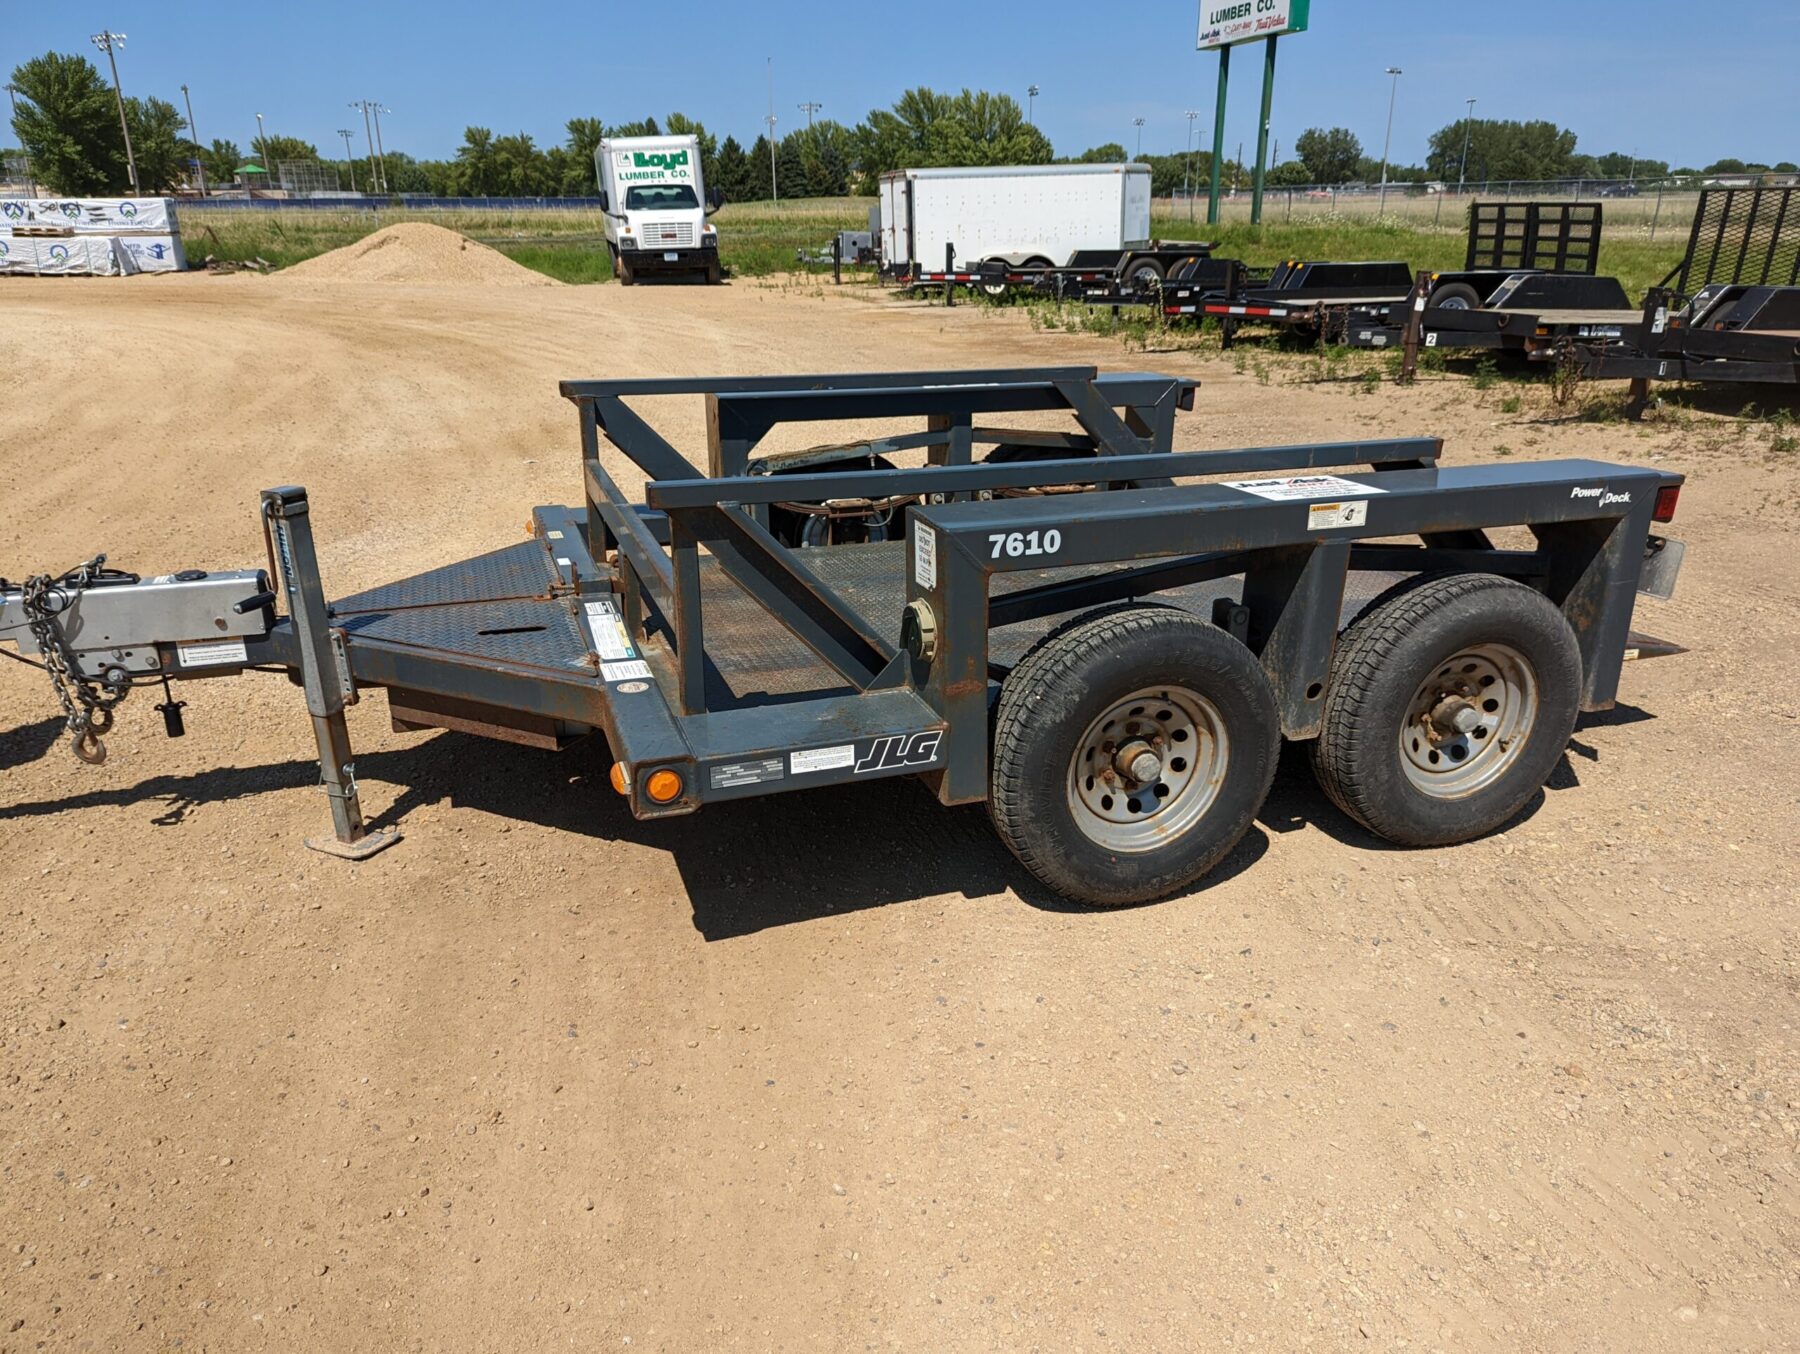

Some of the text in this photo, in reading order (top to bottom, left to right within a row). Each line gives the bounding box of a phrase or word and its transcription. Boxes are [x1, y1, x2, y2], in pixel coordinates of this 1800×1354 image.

[1210, 0, 1276, 25] LUMBER CO.
[619, 169, 690, 180] LUMBER CO.
[1428, 335, 1435, 344] 2
[1571, 487, 1603, 498] Power
[1605, 492, 1631, 503] Deck
[988, 529, 1062, 559] 7610
[854, 731, 943, 773] JLG
